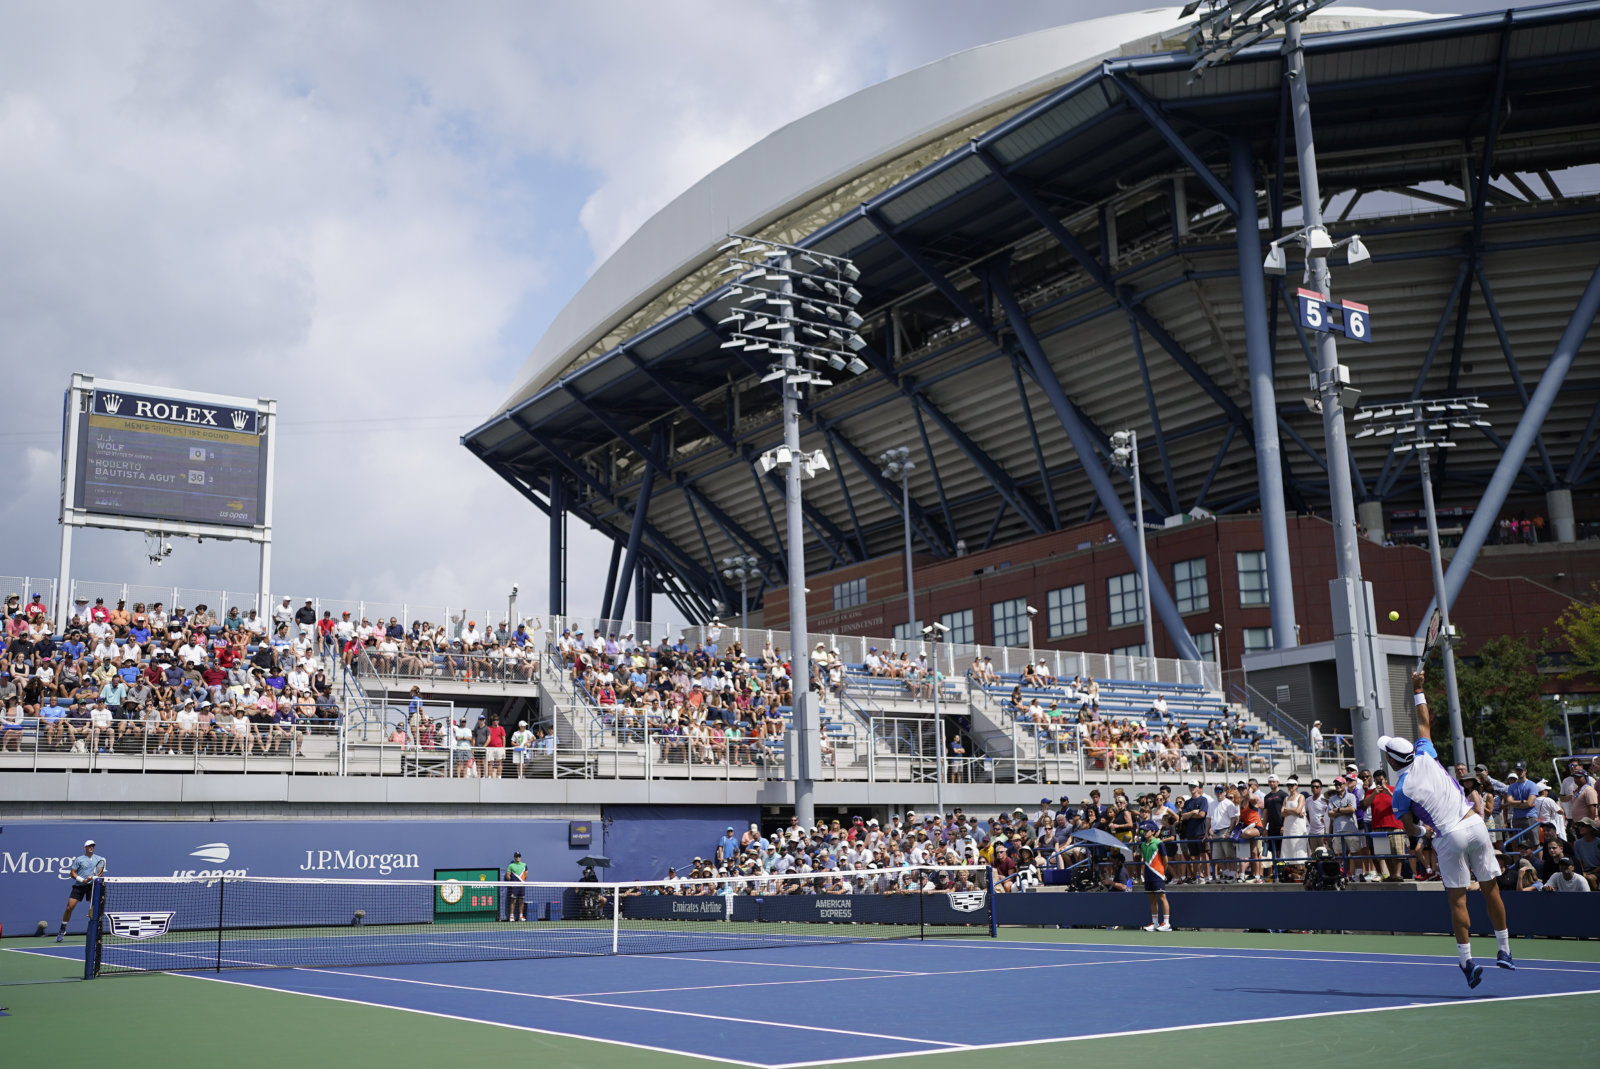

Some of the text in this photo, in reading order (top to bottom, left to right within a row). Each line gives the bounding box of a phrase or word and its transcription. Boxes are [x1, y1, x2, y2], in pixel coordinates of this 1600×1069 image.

[1307, 300, 1322, 327] 5
[1350, 312, 1365, 338] 6
[135, 401, 218, 426] ROLEX
[96, 441, 125, 451] WOLF
[95, 460, 142, 471] ROBERTO
[95, 467, 146, 480] BAUTISTA
[148, 474, 176, 483] AGUT
[191, 474, 203, 482] 30
[1, 851, 107, 880] Morg
[300, 850, 420, 875] J.P.Morgan
[471, 895, 494, 907] 0:34
[672, 901, 722, 913] Emirates Airline
[815, 899, 852, 908] AMERICAN
[820, 909, 852, 918] EXPRESS
